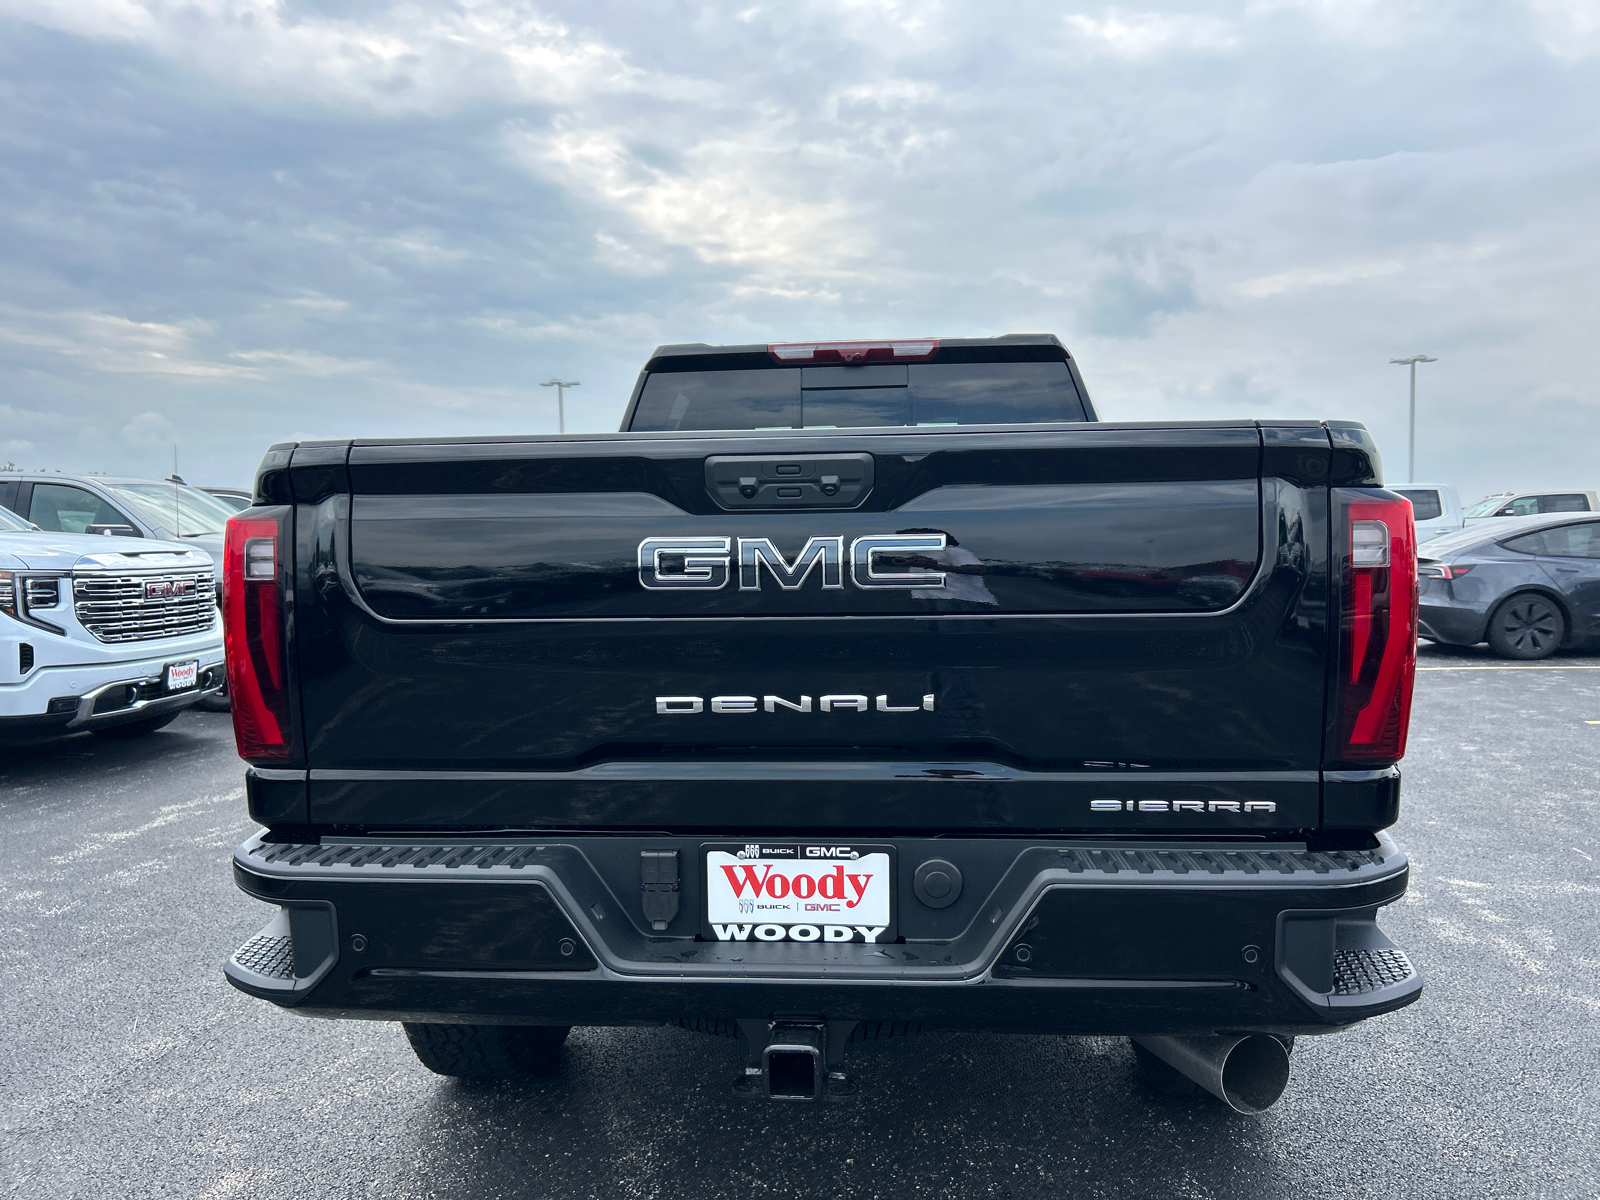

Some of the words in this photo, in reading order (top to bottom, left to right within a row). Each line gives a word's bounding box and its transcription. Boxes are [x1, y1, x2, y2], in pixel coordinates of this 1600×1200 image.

[637, 534, 947, 592] GMC
[146, 581, 196, 598] GMC
[171, 666, 195, 678] Woody
[170, 680, 196, 690] WOODY
[655, 693, 935, 714] DENALI
[1090, 799, 1276, 813] SIERRA
[805, 846, 851, 858] GMC
[719, 864, 874, 909] Woody
[804, 903, 841, 912] GMC
[711, 923, 887, 944] WOODY
